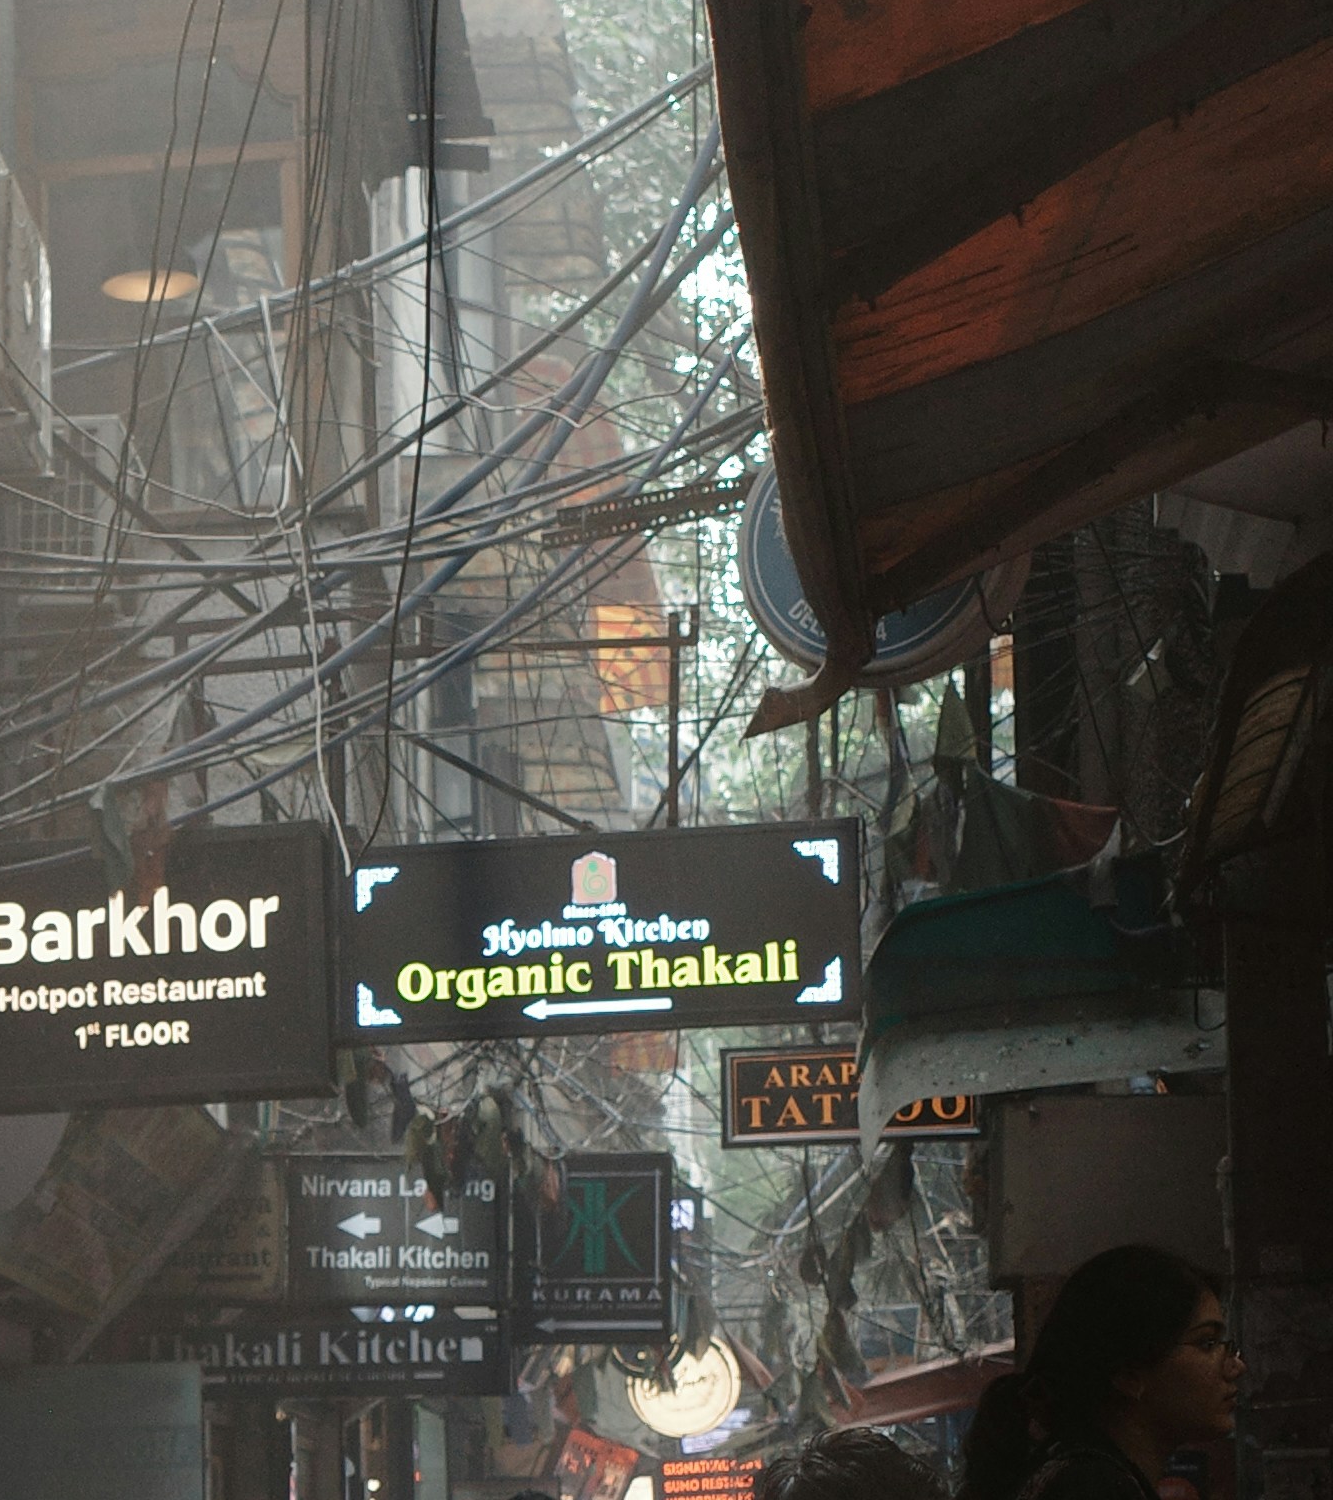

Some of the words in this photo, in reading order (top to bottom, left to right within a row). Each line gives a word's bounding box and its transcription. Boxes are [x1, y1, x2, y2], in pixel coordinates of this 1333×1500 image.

[482, 918, 593, 957] Hyolmo
[598, 913, 710, 947] Kitchen
[103, 971, 267, 1006] Restaurant
[397, 952, 593, 1010] Organic
[607, 939, 800, 991] Thakali
[74, 1021, 101, 1050] 1st
[105, 1020, 190, 1048] FLOOR
[763, 1062, 864, 1089] ARAP
[301, 1174, 392, 1197] Nirvana
[306, 1245, 391, 1269] Thakali
[398, 1244, 490, 1270] Kitchen
[531, 1287, 663, 1303] KURAMA
[318, 1328, 484, 1367] Kitchen
